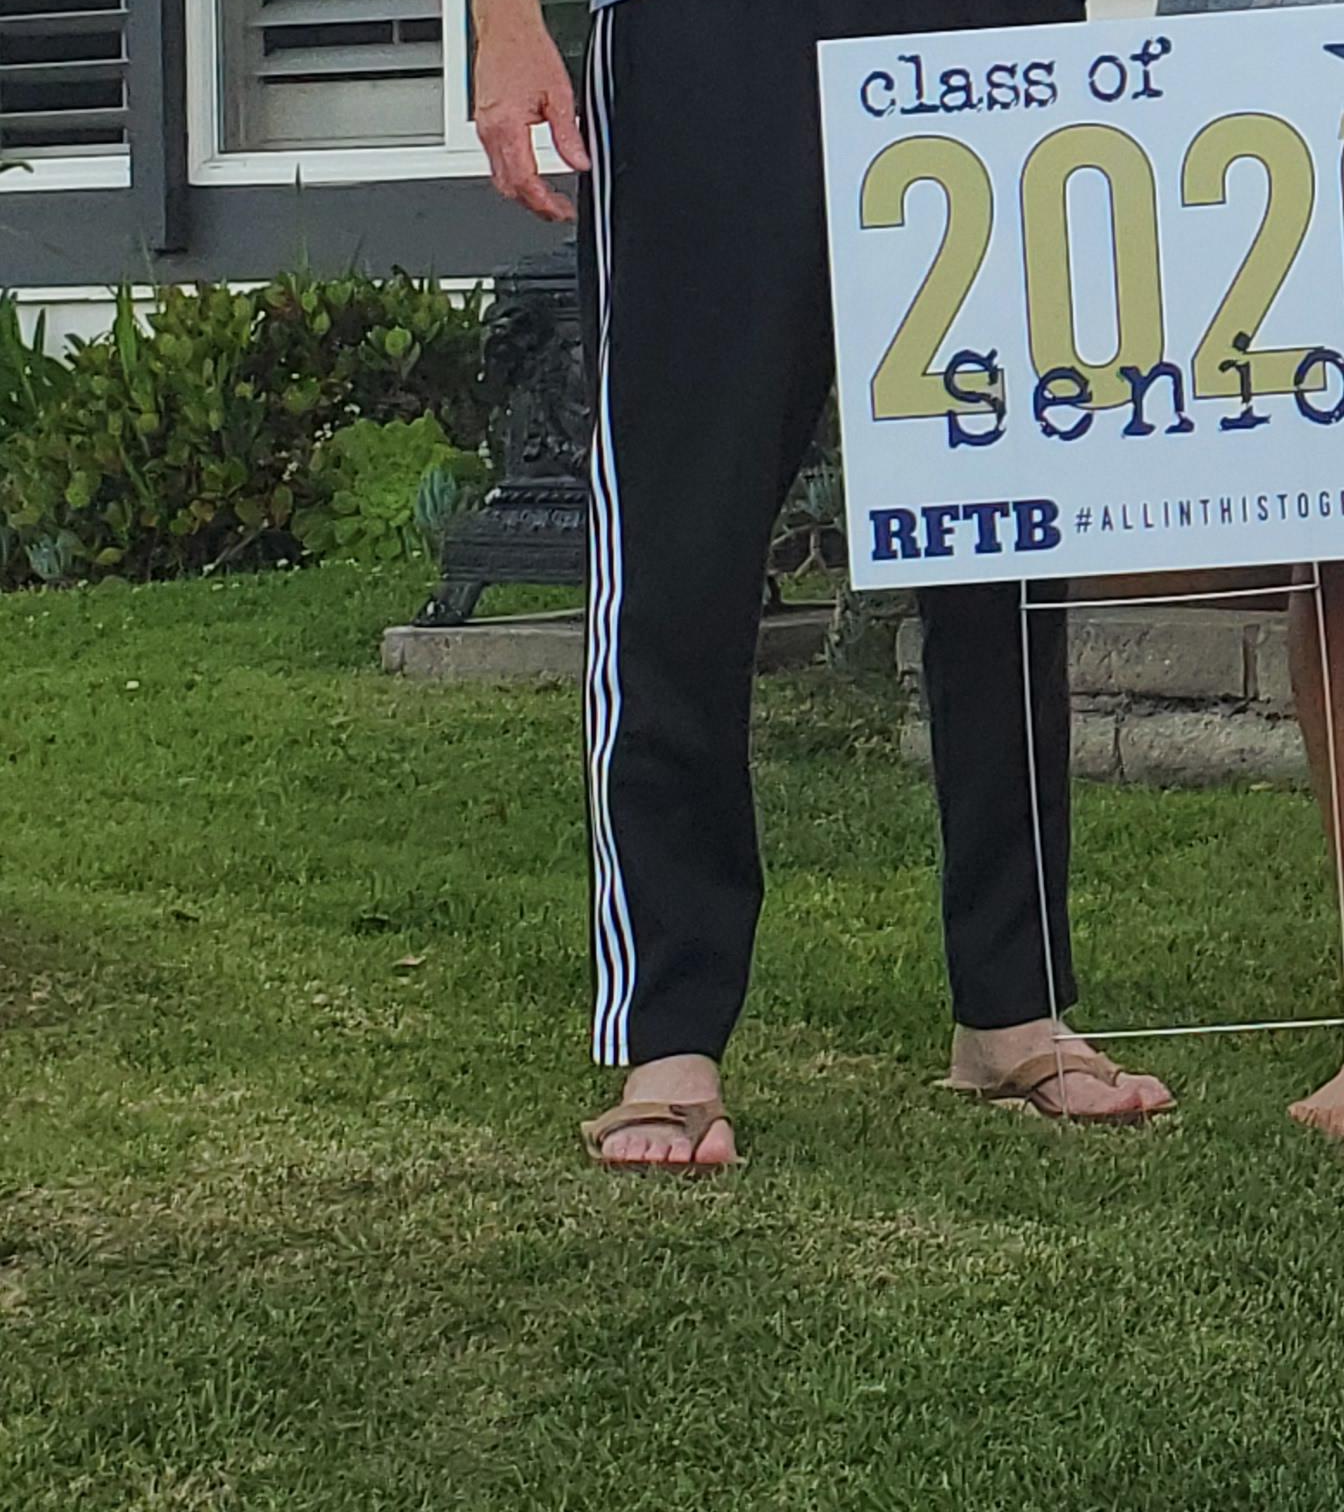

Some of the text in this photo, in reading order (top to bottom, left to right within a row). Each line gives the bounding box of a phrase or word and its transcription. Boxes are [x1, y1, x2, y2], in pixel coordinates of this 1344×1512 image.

[860, 36, 1172, 117] class of
[869, 499, 1061, 561] RFTB
